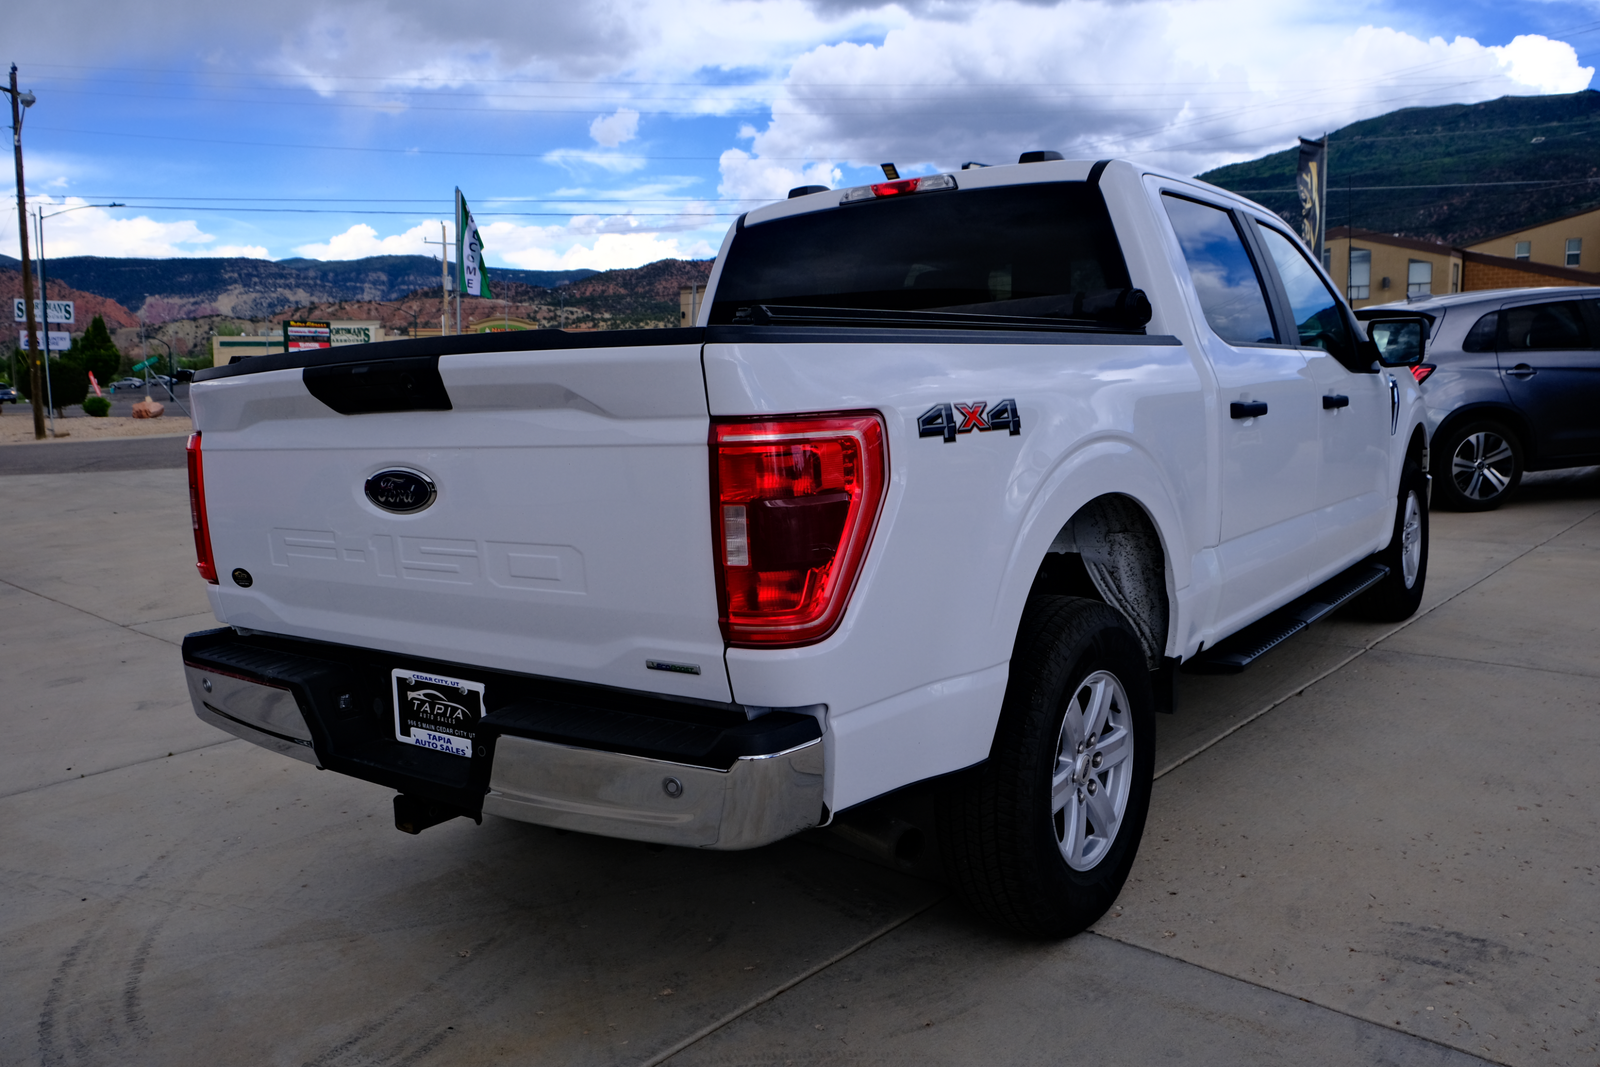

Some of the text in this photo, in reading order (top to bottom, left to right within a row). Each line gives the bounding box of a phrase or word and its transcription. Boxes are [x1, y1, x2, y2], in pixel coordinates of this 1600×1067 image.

[16, 301, 72, 320] SRMAN'S
[331, 327, 371, 343] ORTSMAN'S
[267, 527, 588, 595] F-150
[412, 674, 433, 682] CEDAR
[433, 678, 449, 686] CITY,
[413, 700, 463, 720] TAPIA
[437, 716, 456, 725] SALES
[422, 722, 435, 731] MAIN
[436, 725, 454, 734] CEDAR
[454, 729, 467, 737] CITY
[415, 738, 466, 756] AUTO SALES
[427, 733, 452, 745] TAPIA
